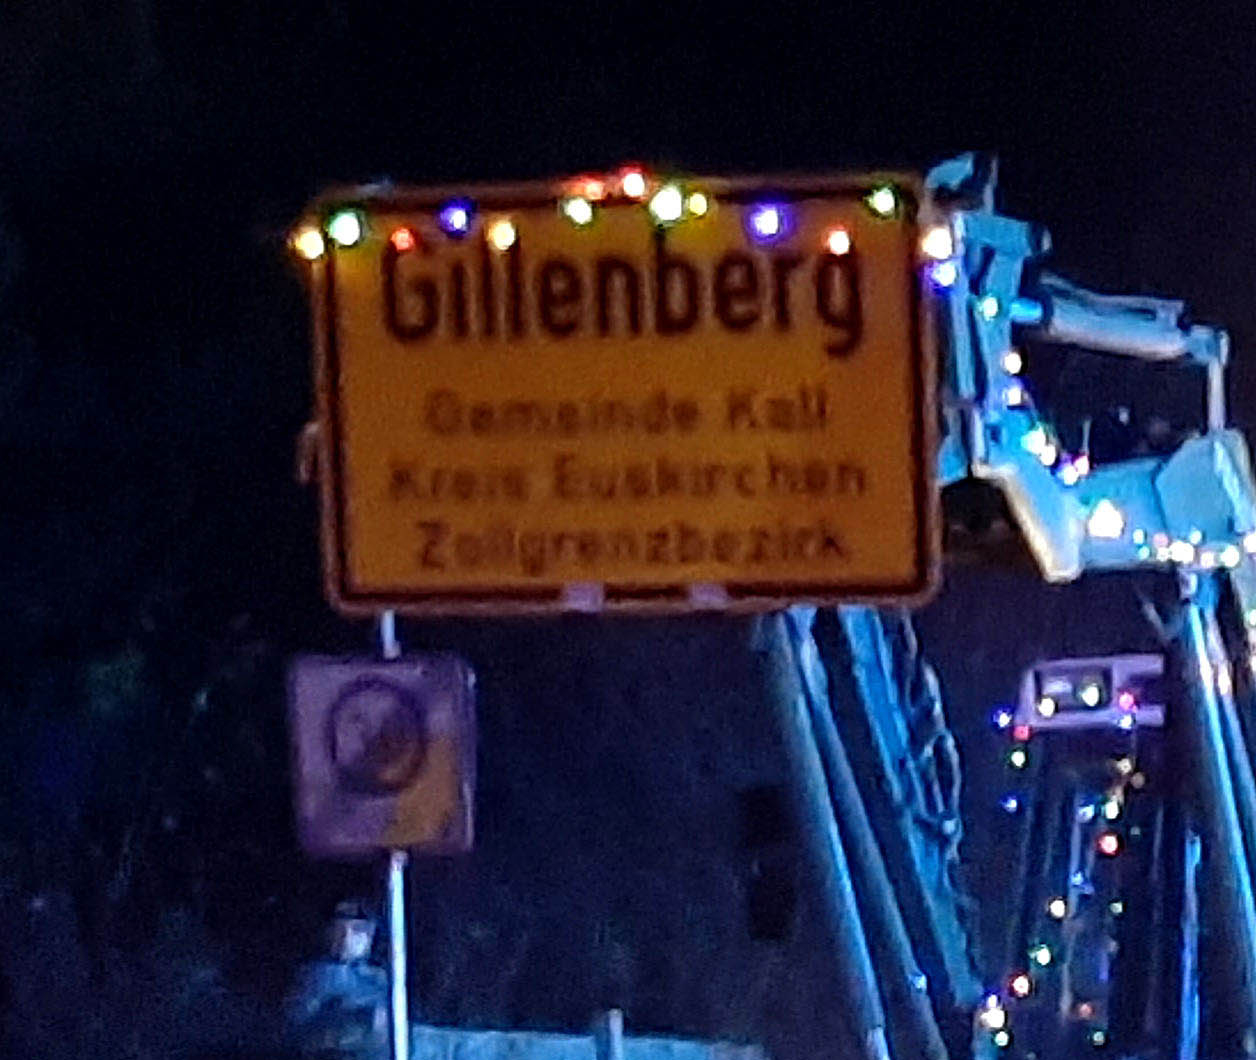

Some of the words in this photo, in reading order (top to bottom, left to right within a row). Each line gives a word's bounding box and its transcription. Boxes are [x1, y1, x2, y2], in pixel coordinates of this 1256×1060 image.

[380, 225, 864, 358] Gillenberg
[424, 388, 701, 436] Gemeinde
[727, 383, 830, 432] Kall
[388, 458, 529, 501] Kreis
[553, 452, 868, 500] Euskirchen
